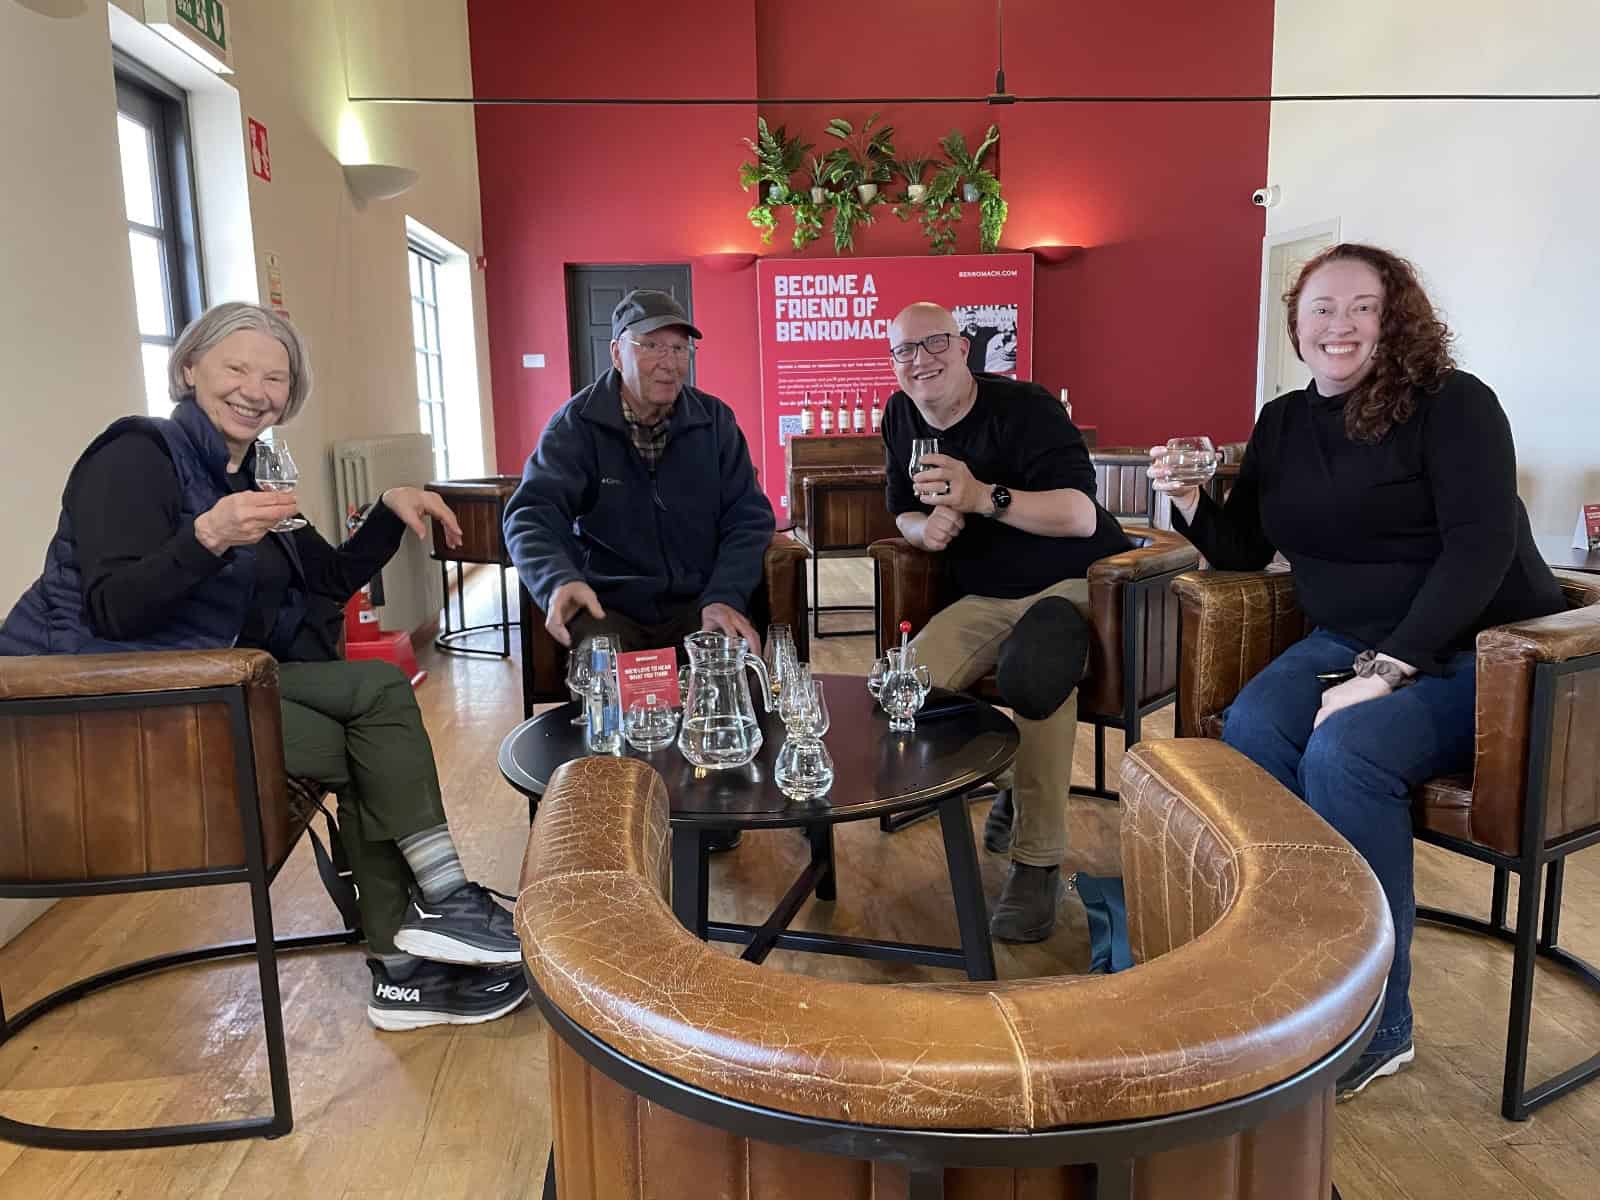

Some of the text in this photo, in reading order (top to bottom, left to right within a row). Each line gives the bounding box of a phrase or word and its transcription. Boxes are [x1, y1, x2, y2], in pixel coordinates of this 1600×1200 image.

[774, 273, 877, 296] BECOME A
[959, 270, 1018, 278] BENROMACH.COM
[775, 296, 879, 319] FRIEND OF
[375, 983, 421, 1002] HOKA
